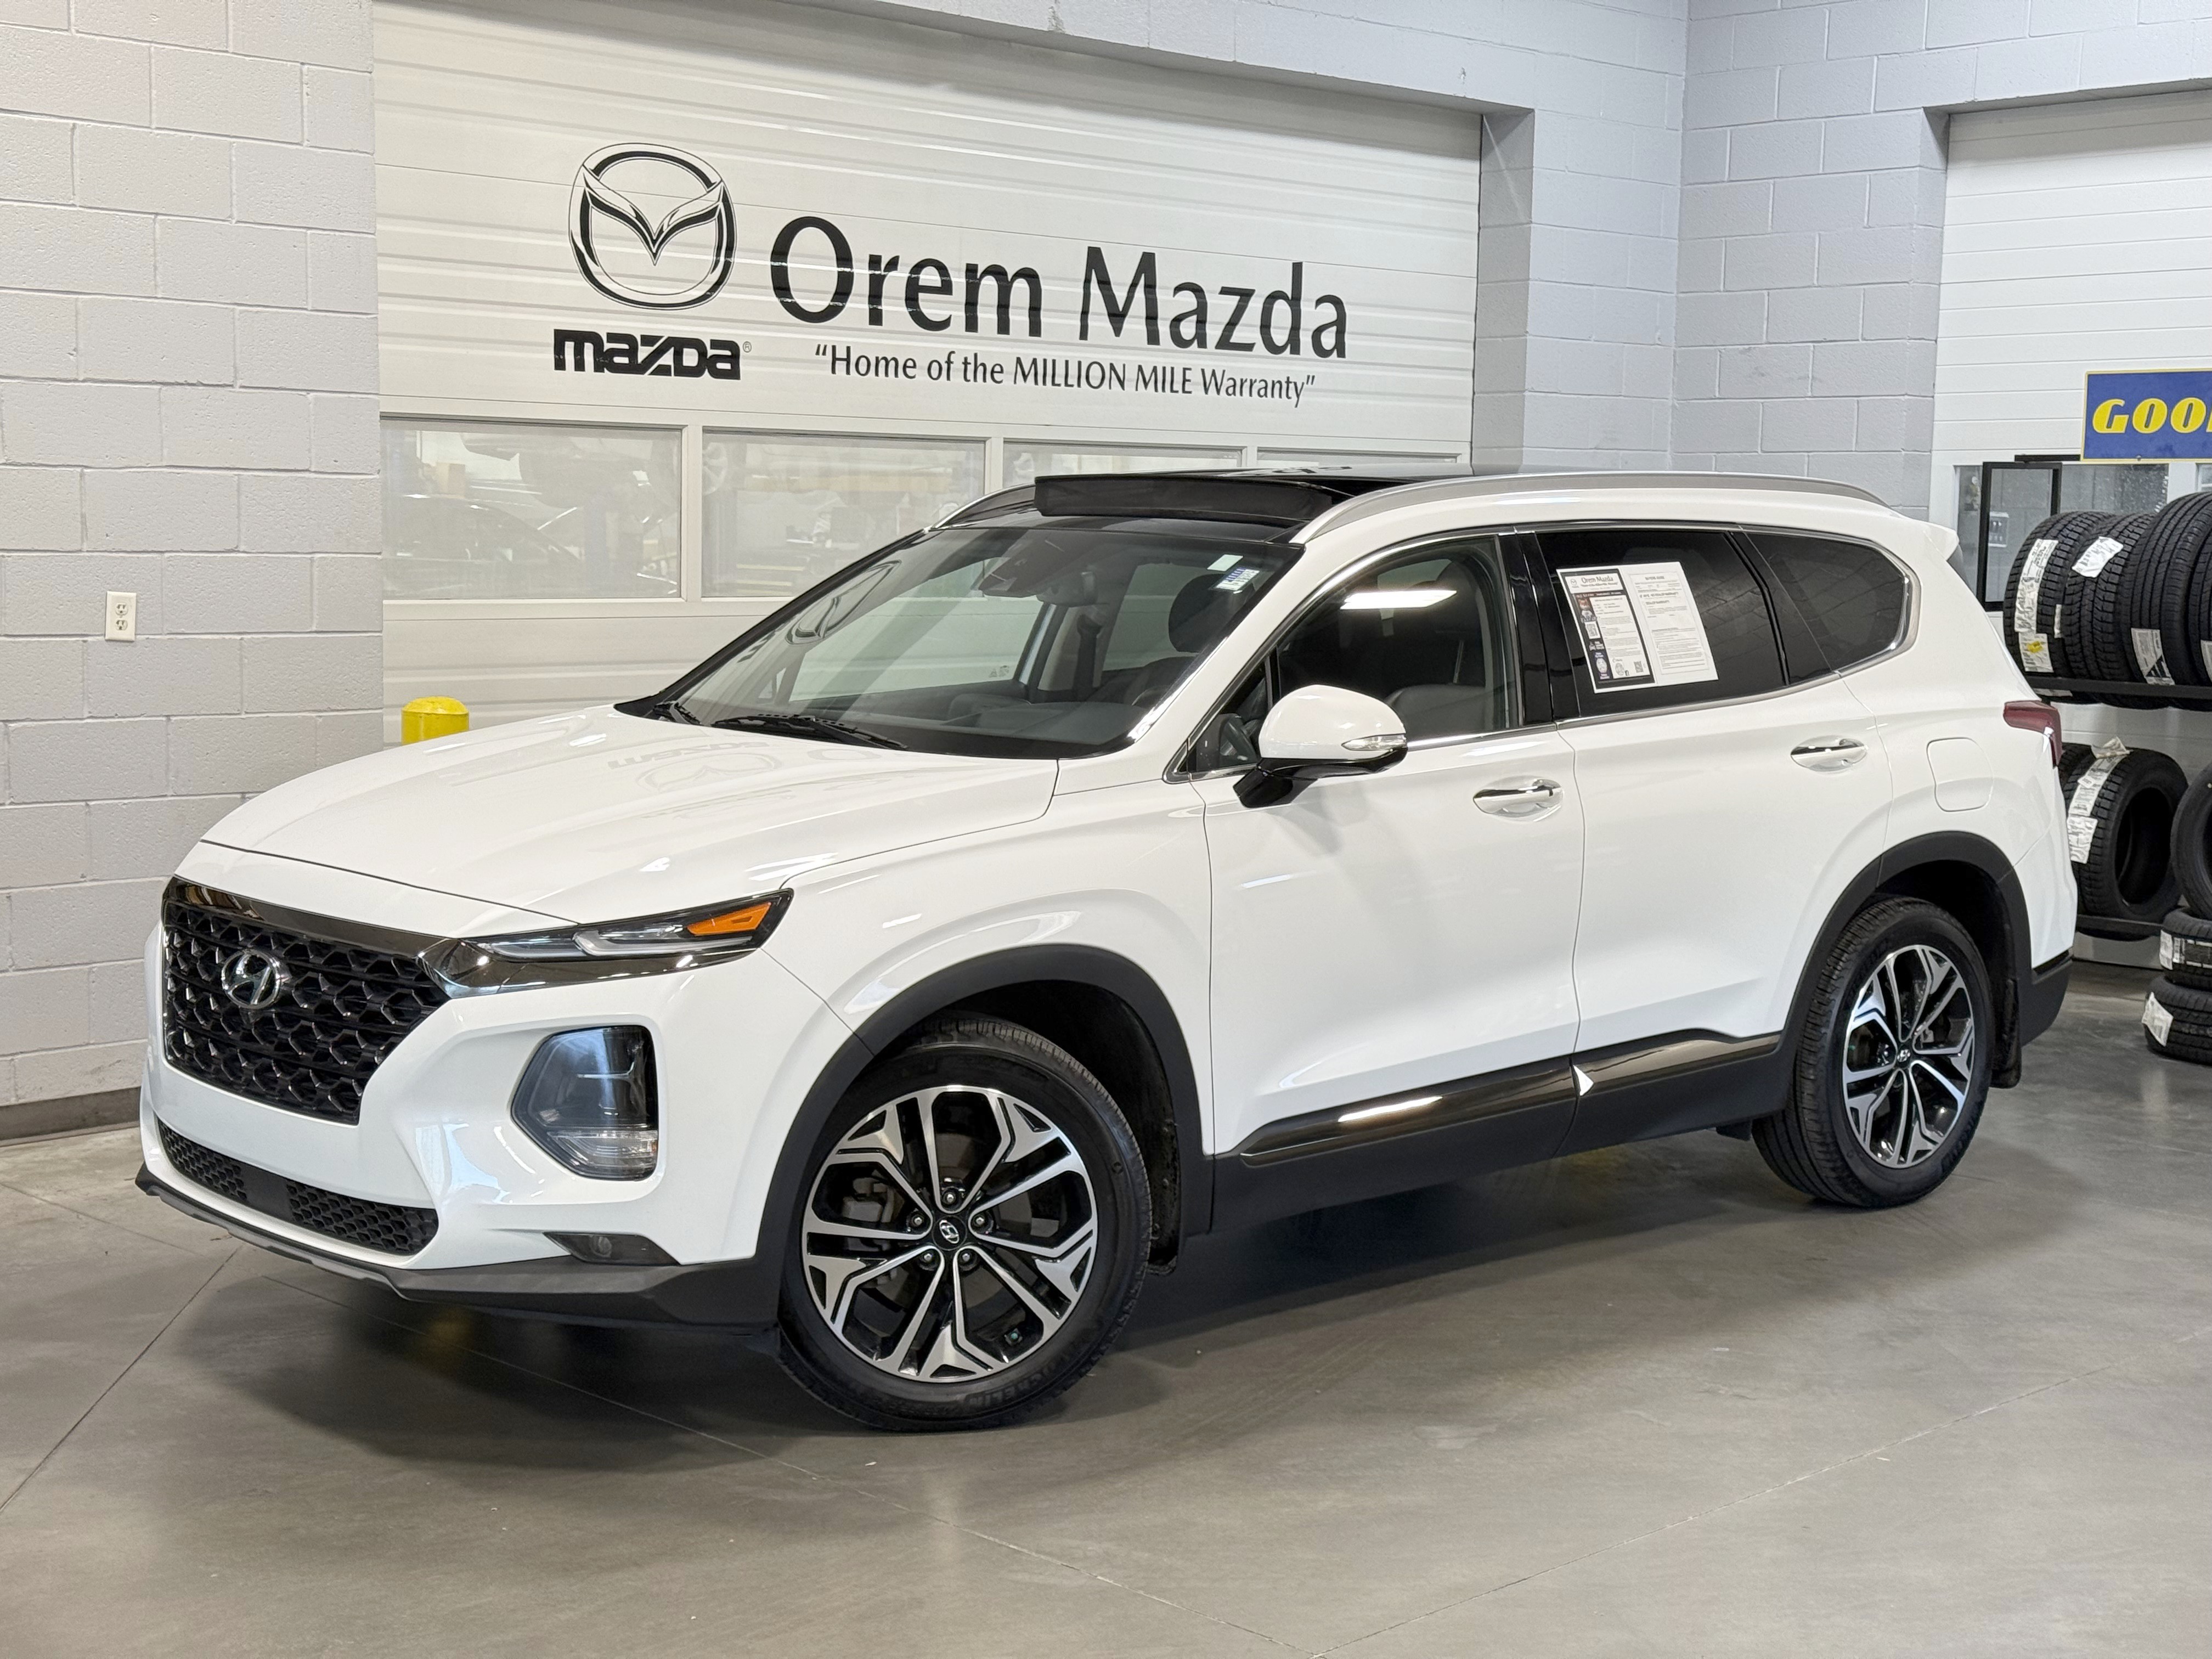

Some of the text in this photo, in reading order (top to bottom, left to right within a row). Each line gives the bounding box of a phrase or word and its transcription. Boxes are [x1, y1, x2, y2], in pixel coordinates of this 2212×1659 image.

[770, 216, 1347, 359] Orem Mazda
[927, 351, 956, 382] of
[962, 352, 1005, 385] the
[1013, 356, 1126, 391] MILLION
[1135, 364, 1193, 395] MILE
[2092, 397, 2212, 433] GOO
